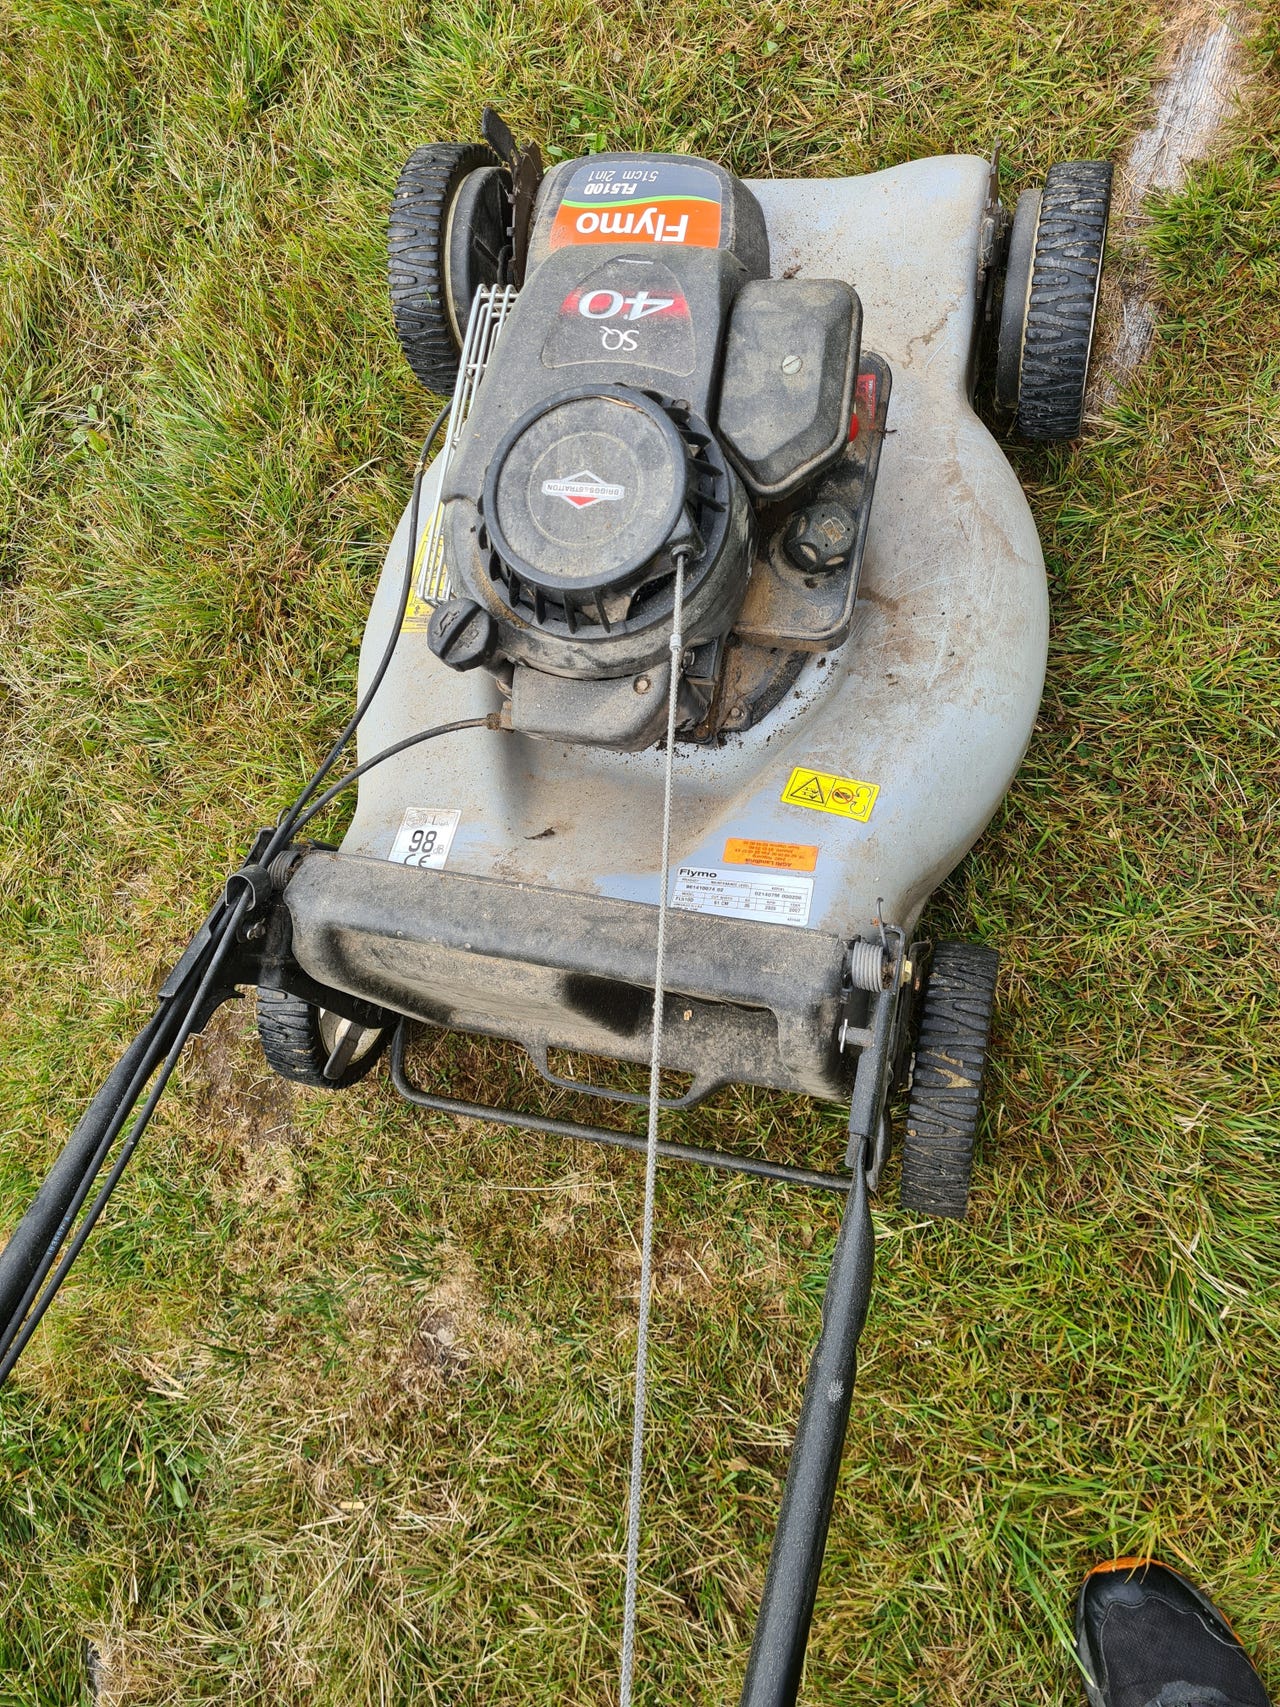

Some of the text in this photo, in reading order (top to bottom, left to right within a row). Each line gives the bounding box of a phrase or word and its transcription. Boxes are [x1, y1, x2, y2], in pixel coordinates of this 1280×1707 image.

[588, 170, 660, 182] 51cm 2in1
[584, 183, 638, 195] FL510D
[576, 207, 689, 243] Flymo
[599, 325, 640, 351] SQ
[408, 829, 437, 853] 98
[679, 868, 718, 878] Flymo
